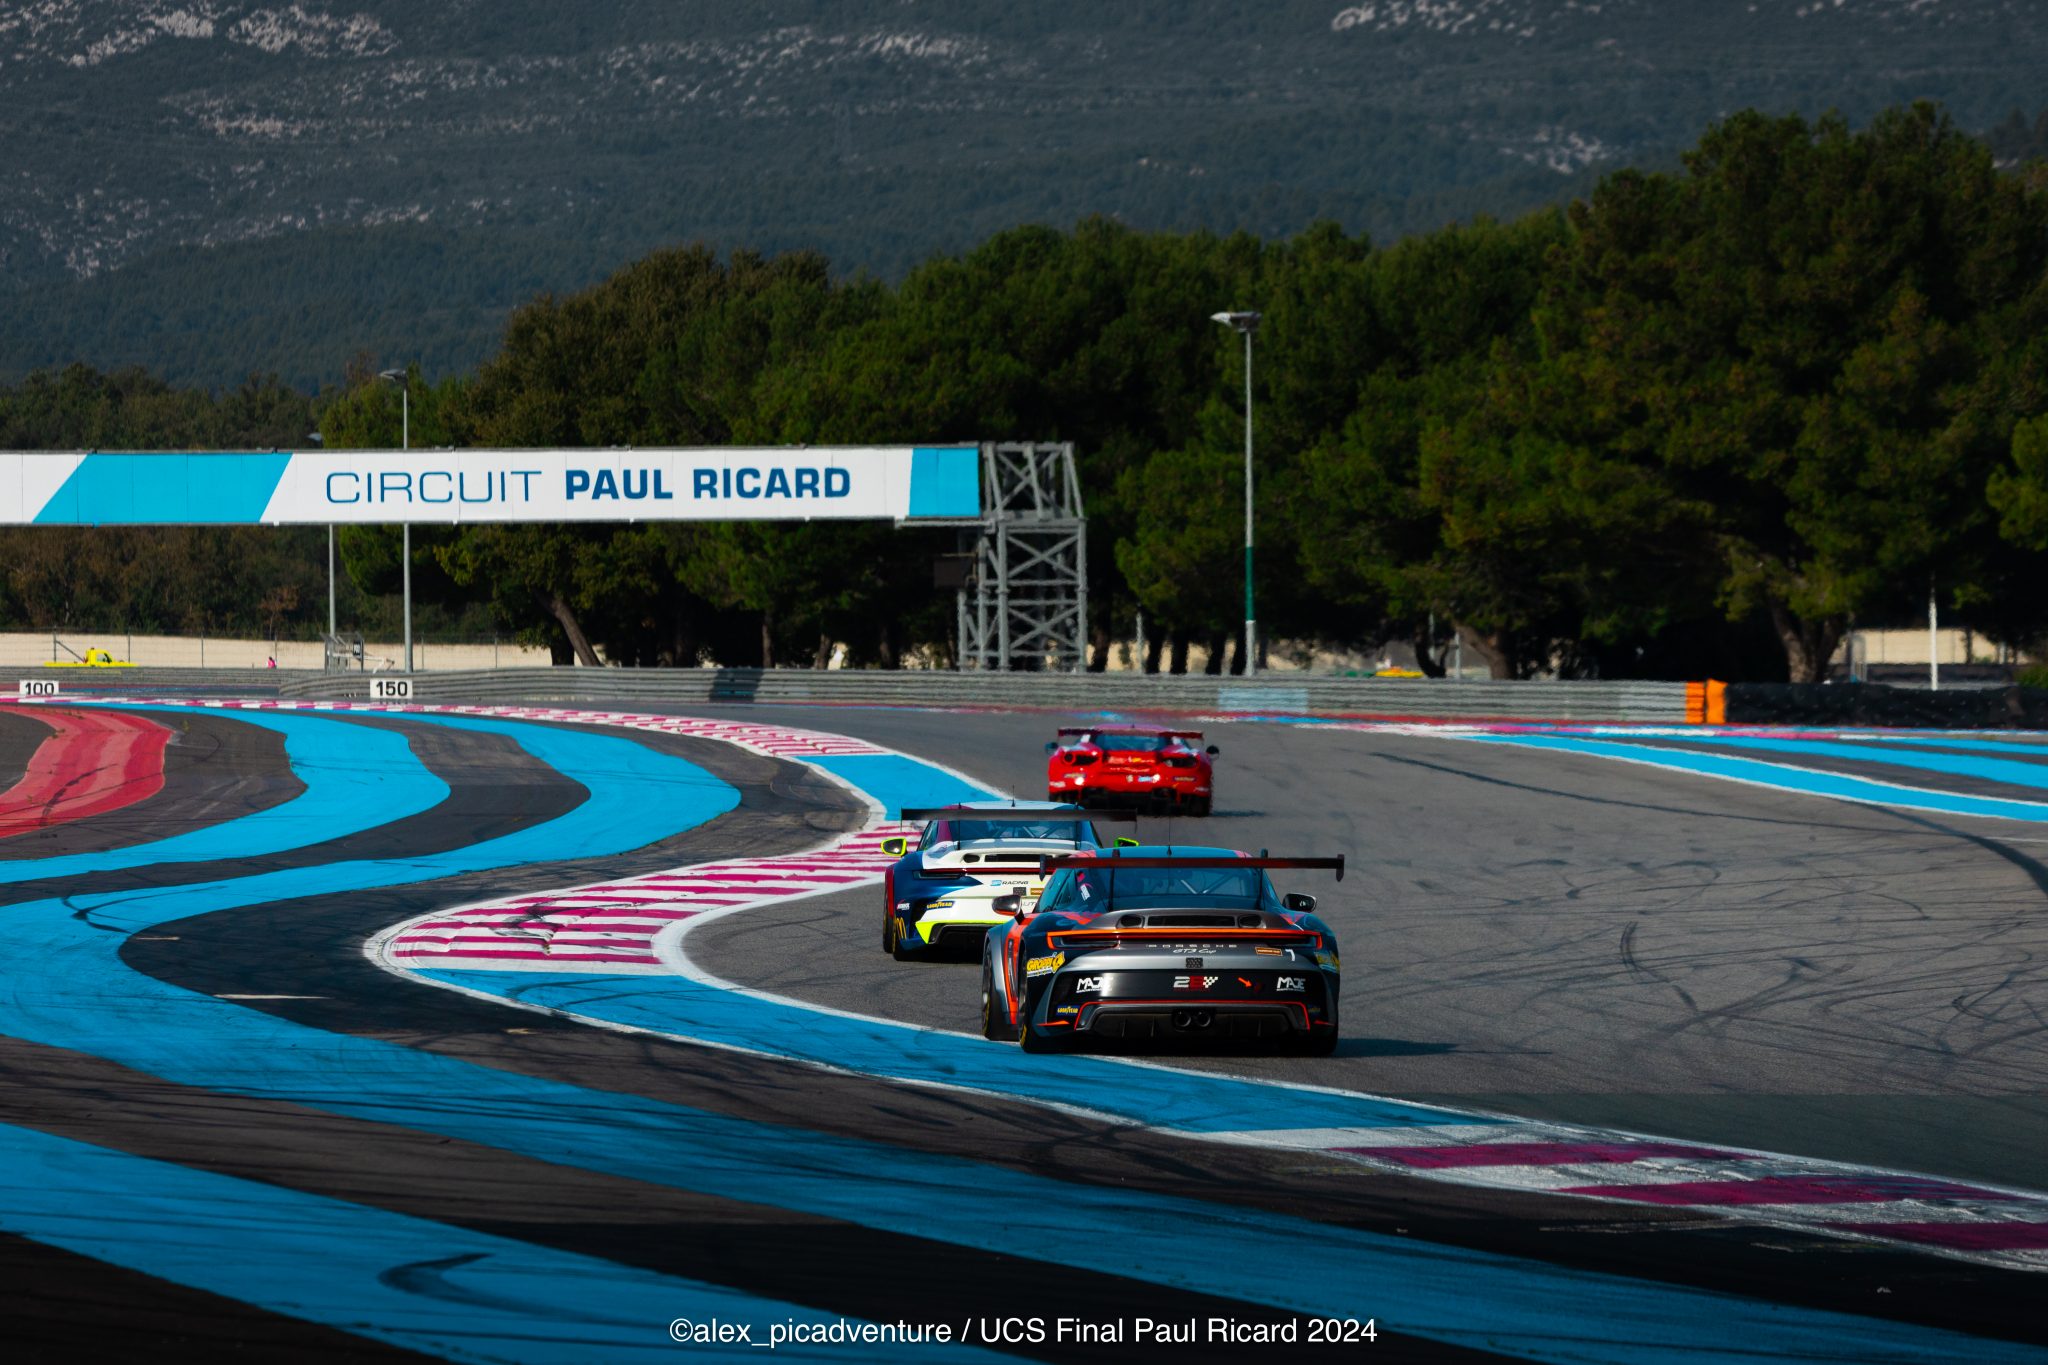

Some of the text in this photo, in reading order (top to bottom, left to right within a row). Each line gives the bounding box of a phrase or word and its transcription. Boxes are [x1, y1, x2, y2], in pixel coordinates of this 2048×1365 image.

[326, 467, 851, 504] CIRCUIT PAUL RICARD
[25, 682, 54, 695] 100
[376, 681, 408, 697] 150
